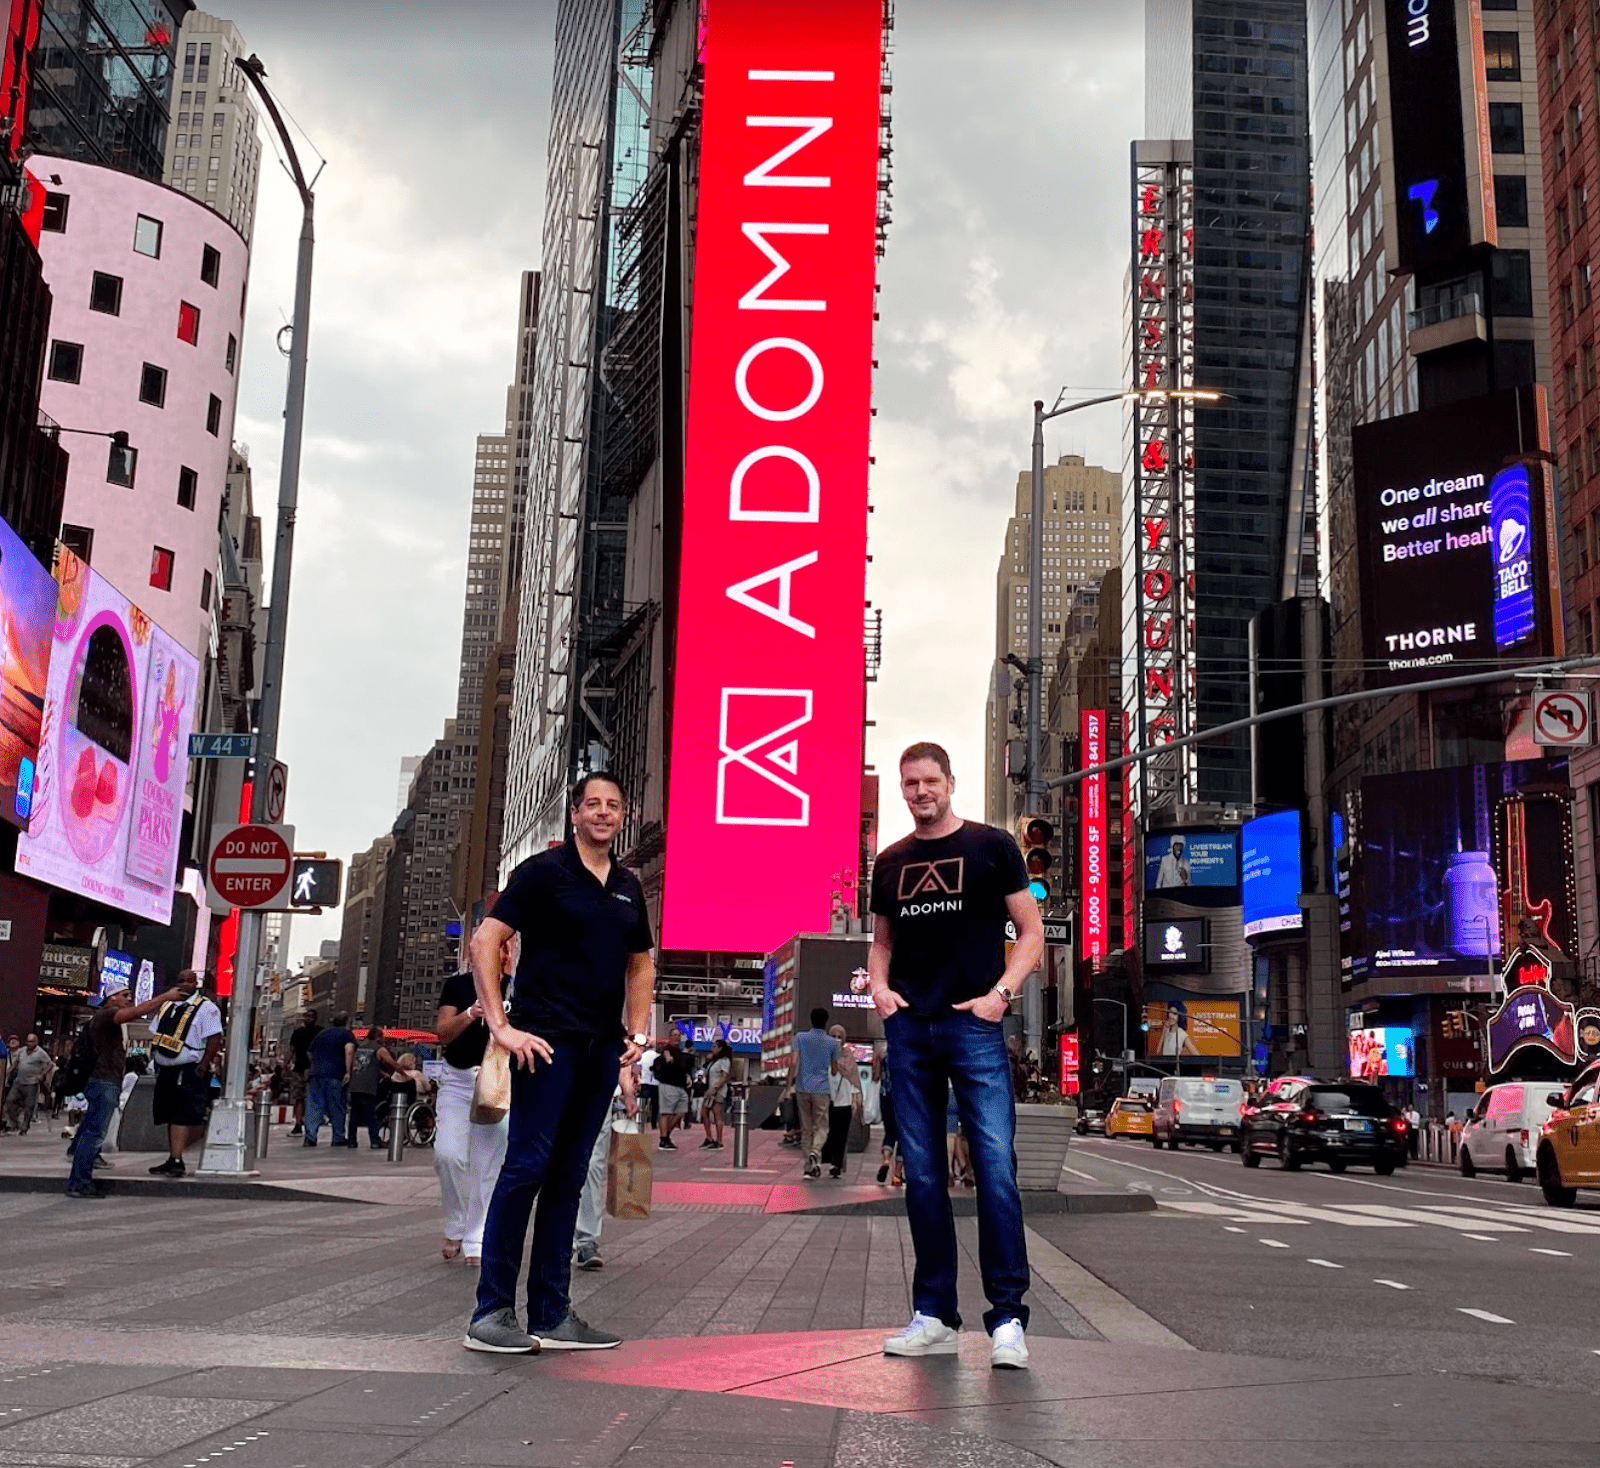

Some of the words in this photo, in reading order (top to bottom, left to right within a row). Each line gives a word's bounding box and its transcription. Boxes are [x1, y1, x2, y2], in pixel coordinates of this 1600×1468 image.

[1140, 184, 1165, 390] ERNST
[725, 69, 835, 639] ADOMNI
[1380, 485, 1420, 506] One
[1423, 473, 1484, 498] dream
[1382, 516, 1409, 534] we
[1412, 507, 1437, 528] all
[1440, 500, 1492, 523] share
[1383, 538, 1442, 562] Better
[1446, 525, 1493, 550] healt
[1498, 560, 1528, 583] TACO
[1501, 576, 1529, 600] BELL
[1143, 517, 1174, 748] YOUNG
[1385, 623, 1476, 651] THORNE
[1388, 652, 1453, 671] thorne.com
[192, 736, 205, 754] W
[210, 736, 233, 755] 44
[240, 737, 250, 747] ST
[1088, 762, 1099, 781] 22
[1089, 825, 1099, 842] SF
[225, 841, 246, 854] DO
[250, 841, 278, 854] NOT
[1089, 845, 1102, 884] 9,000
[226, 878, 271, 891] ENTER
[900, 900, 962, 917] ADOMNI
[1089, 896, 1102, 935] 3,000
[44, 951, 90, 966] BUCKS
[832, 994, 873, 1003] MARIN
[718, 1018, 762, 1044] YORK
